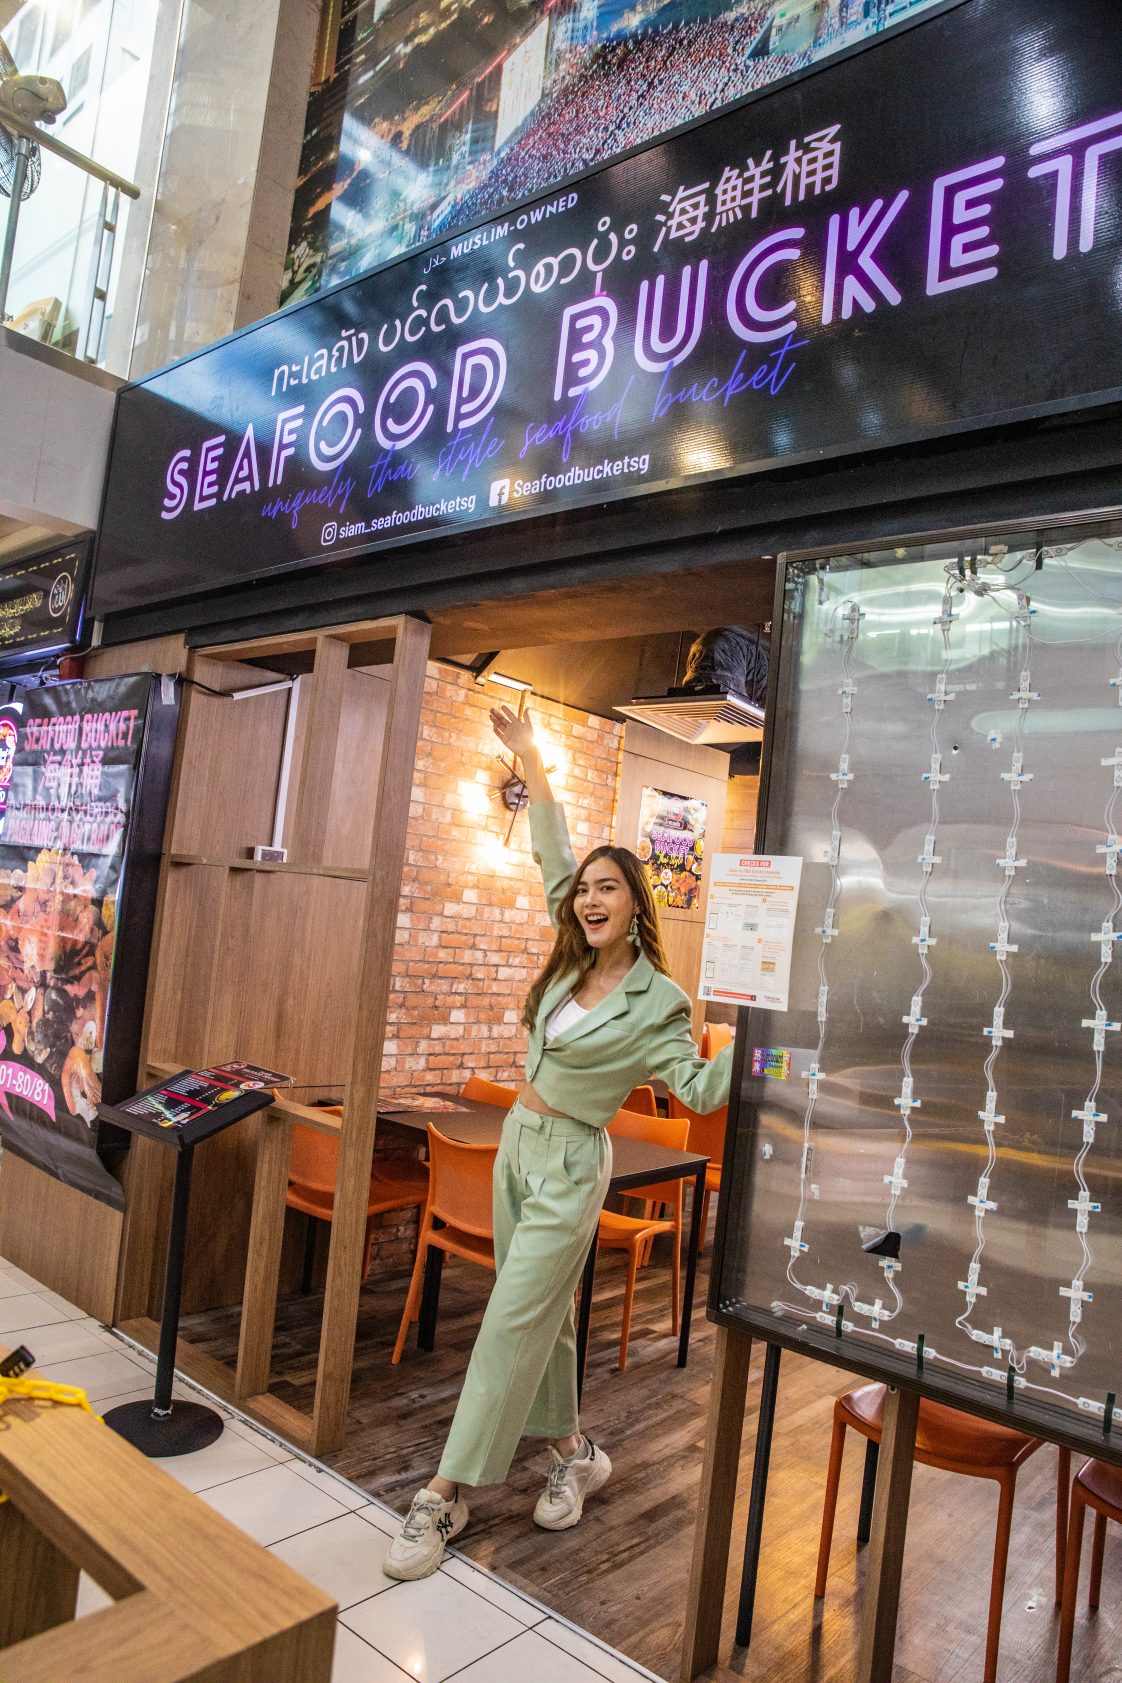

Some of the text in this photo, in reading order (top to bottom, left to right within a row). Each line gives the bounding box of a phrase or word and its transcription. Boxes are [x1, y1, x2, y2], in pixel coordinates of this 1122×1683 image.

[653, 124, 842, 252] 海鮮桶
[450, 192, 579, 260] MUSLIM-OWNED
[423, 255, 447, 274] حلال
[160, 111, 1122, 519] SEAFOOD BUCKET
[262, 334, 810, 529] uniquely thai style seafood bucket
[513, 454, 650, 497] Seafoodbucketsg
[338, 494, 477, 539] siam_seafoodbucketsg
[24, 710, 138, 750] SEAFOOD BUCKET
[651, 828, 695, 858] SEAFOOD BUCKET
